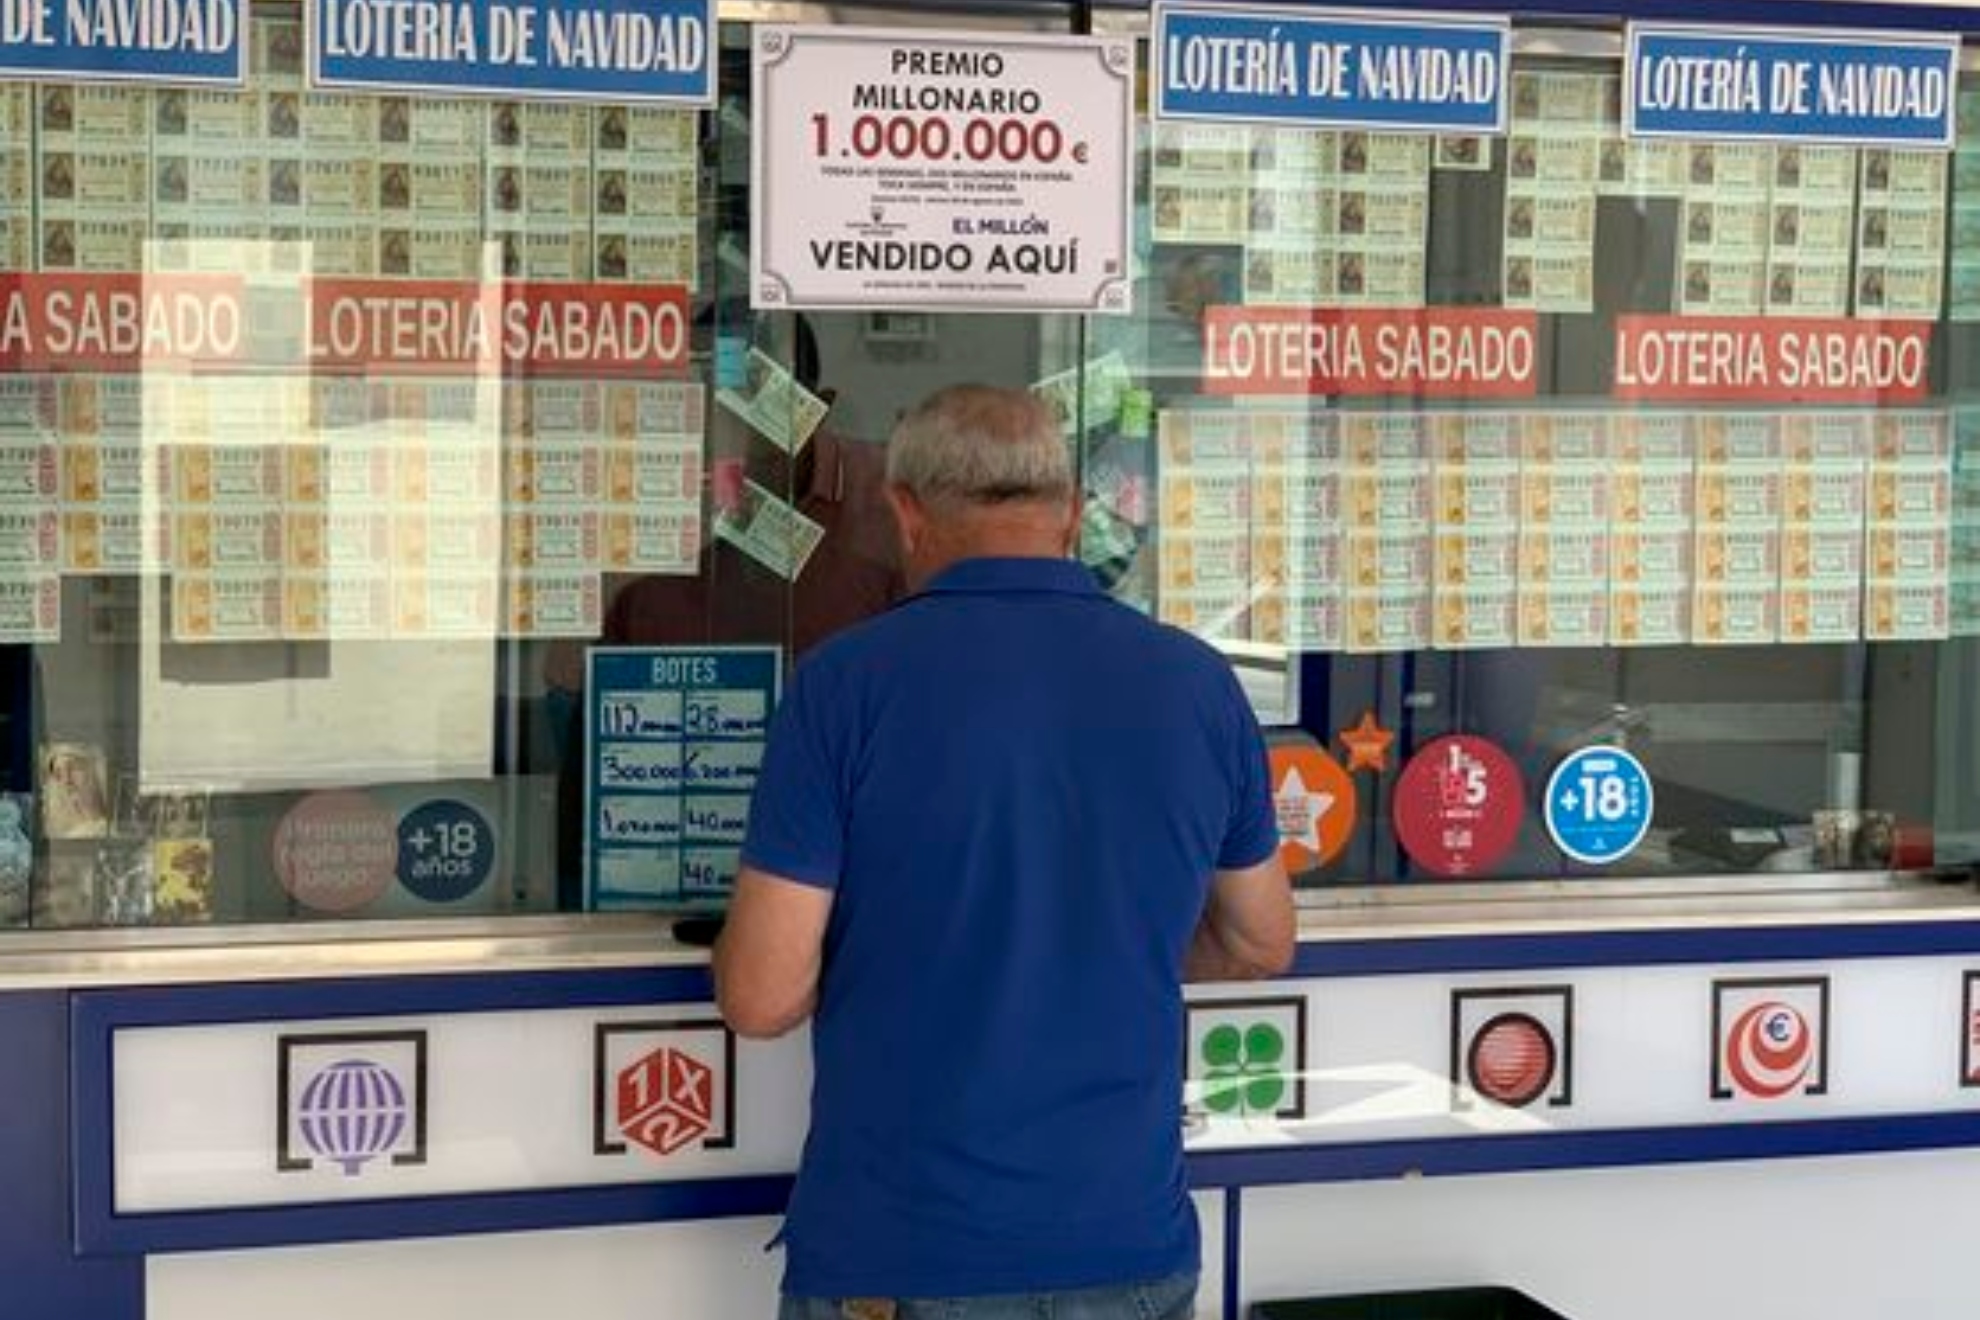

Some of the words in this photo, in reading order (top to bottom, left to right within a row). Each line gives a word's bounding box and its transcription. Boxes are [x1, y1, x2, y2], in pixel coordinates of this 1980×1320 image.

[2, 0, 55, 45] DE
[65, 0, 235, 53] NAVIDAD
[488, 5, 538, 66] DE
[545, 9, 705, 72] NAVIDAD
[891, 49, 1004, 78] PREMIO
[1168, 27, 1298, 97] LOTERÍA
[1307, 42, 1352, 98] DE
[1358, 44, 1496, 104] NAVIDAD
[1639, 46, 1761, 113] LOTERÍA
[1770, 60, 1812, 114] DE
[1817, 61, 1946, 119] NAVIDAD
[852, 84, 1041, 114] MILLONARIO
[811, 113, 1062, 163] 1.000.000
[952, 218, 974, 235] EL
[978, 212, 1050, 236] MILLÓN
[810, 239, 973, 272] VENDIDO
[985, 237, 1079, 276] AQUÍ
[45, 290, 240, 355] SABADO
[305, 296, 492, 358] LOTERIA
[502, 299, 685, 360] SABADO
[1206, 321, 1367, 379] LOTERIA
[1374, 324, 1534, 381] SABADO
[1617, 329, 1769, 386] LOTERIA
[1777, 332, 1923, 388] SABADO
[652, 657, 717, 683] BOTES
[1559, 774, 1628, 822] +18
[406, 821, 477, 857] +18
